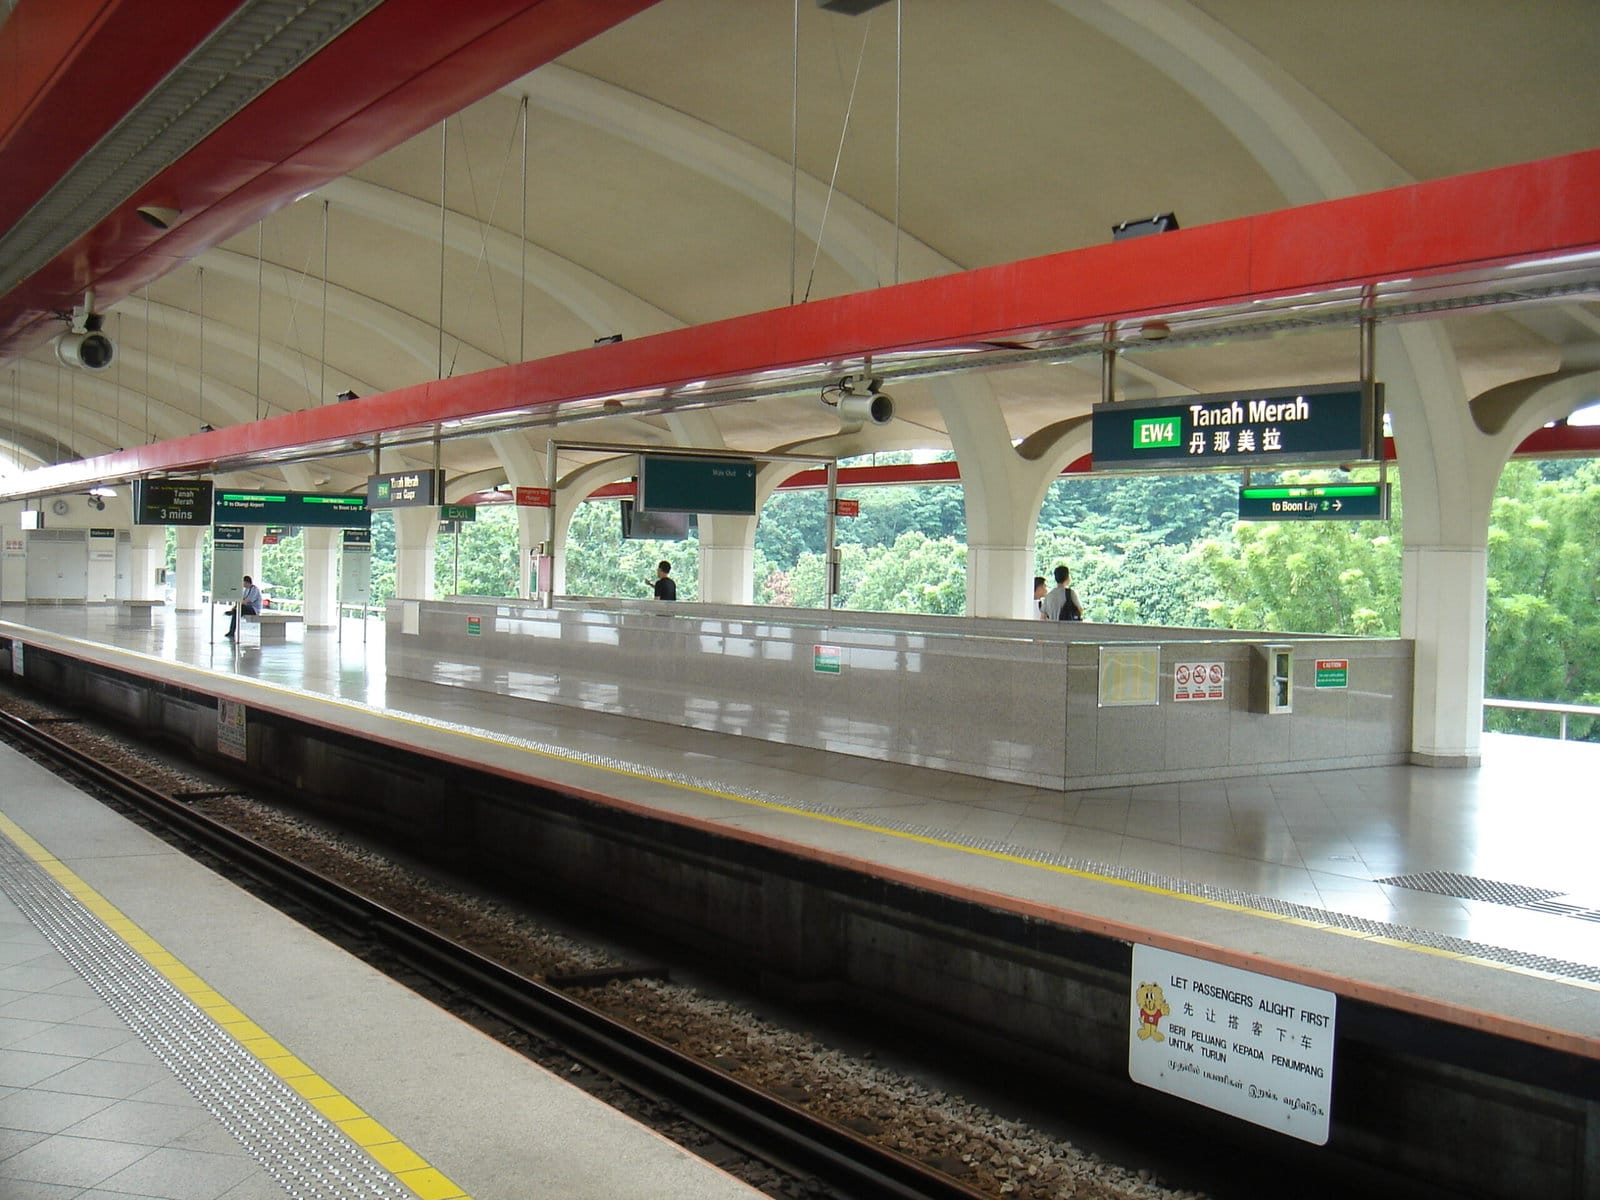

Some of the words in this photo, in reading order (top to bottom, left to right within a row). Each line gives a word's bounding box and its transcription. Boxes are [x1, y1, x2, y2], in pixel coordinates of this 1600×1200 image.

[1190, 401, 1243, 427] Tanah
[1249, 397, 1309, 423] Merah
[1141, 423, 1174, 443] EW4
[1189, 428, 1281, 454] 丹那美拉
[161, 509, 167, 519] 3
[169, 509, 193, 519] mins
[449, 507, 468, 518] Exit
[1272, 502, 1281, 511] to
[1282, 501, 1302, 512] Boon
[1305, 501, 1318, 513] Lay
[1171, 975, 1188, 990] LET
[1193, 981, 1253, 1008] PASSENGERS
[1259, 999, 1295, 1019] ALIGHT
[1301, 1010, 1329, 1028] FIRST
[1169, 1037, 1194, 1053] UNTUK
[1201, 1046, 1227, 1063] TURUN
[1169, 1023, 1186, 1037] BERI
[1191, 1029, 1227, 1049] PELUANG
[1232, 1039, 1264, 1061] KEPADA
[1271, 1054, 1324, 1078] PENUMPANG
